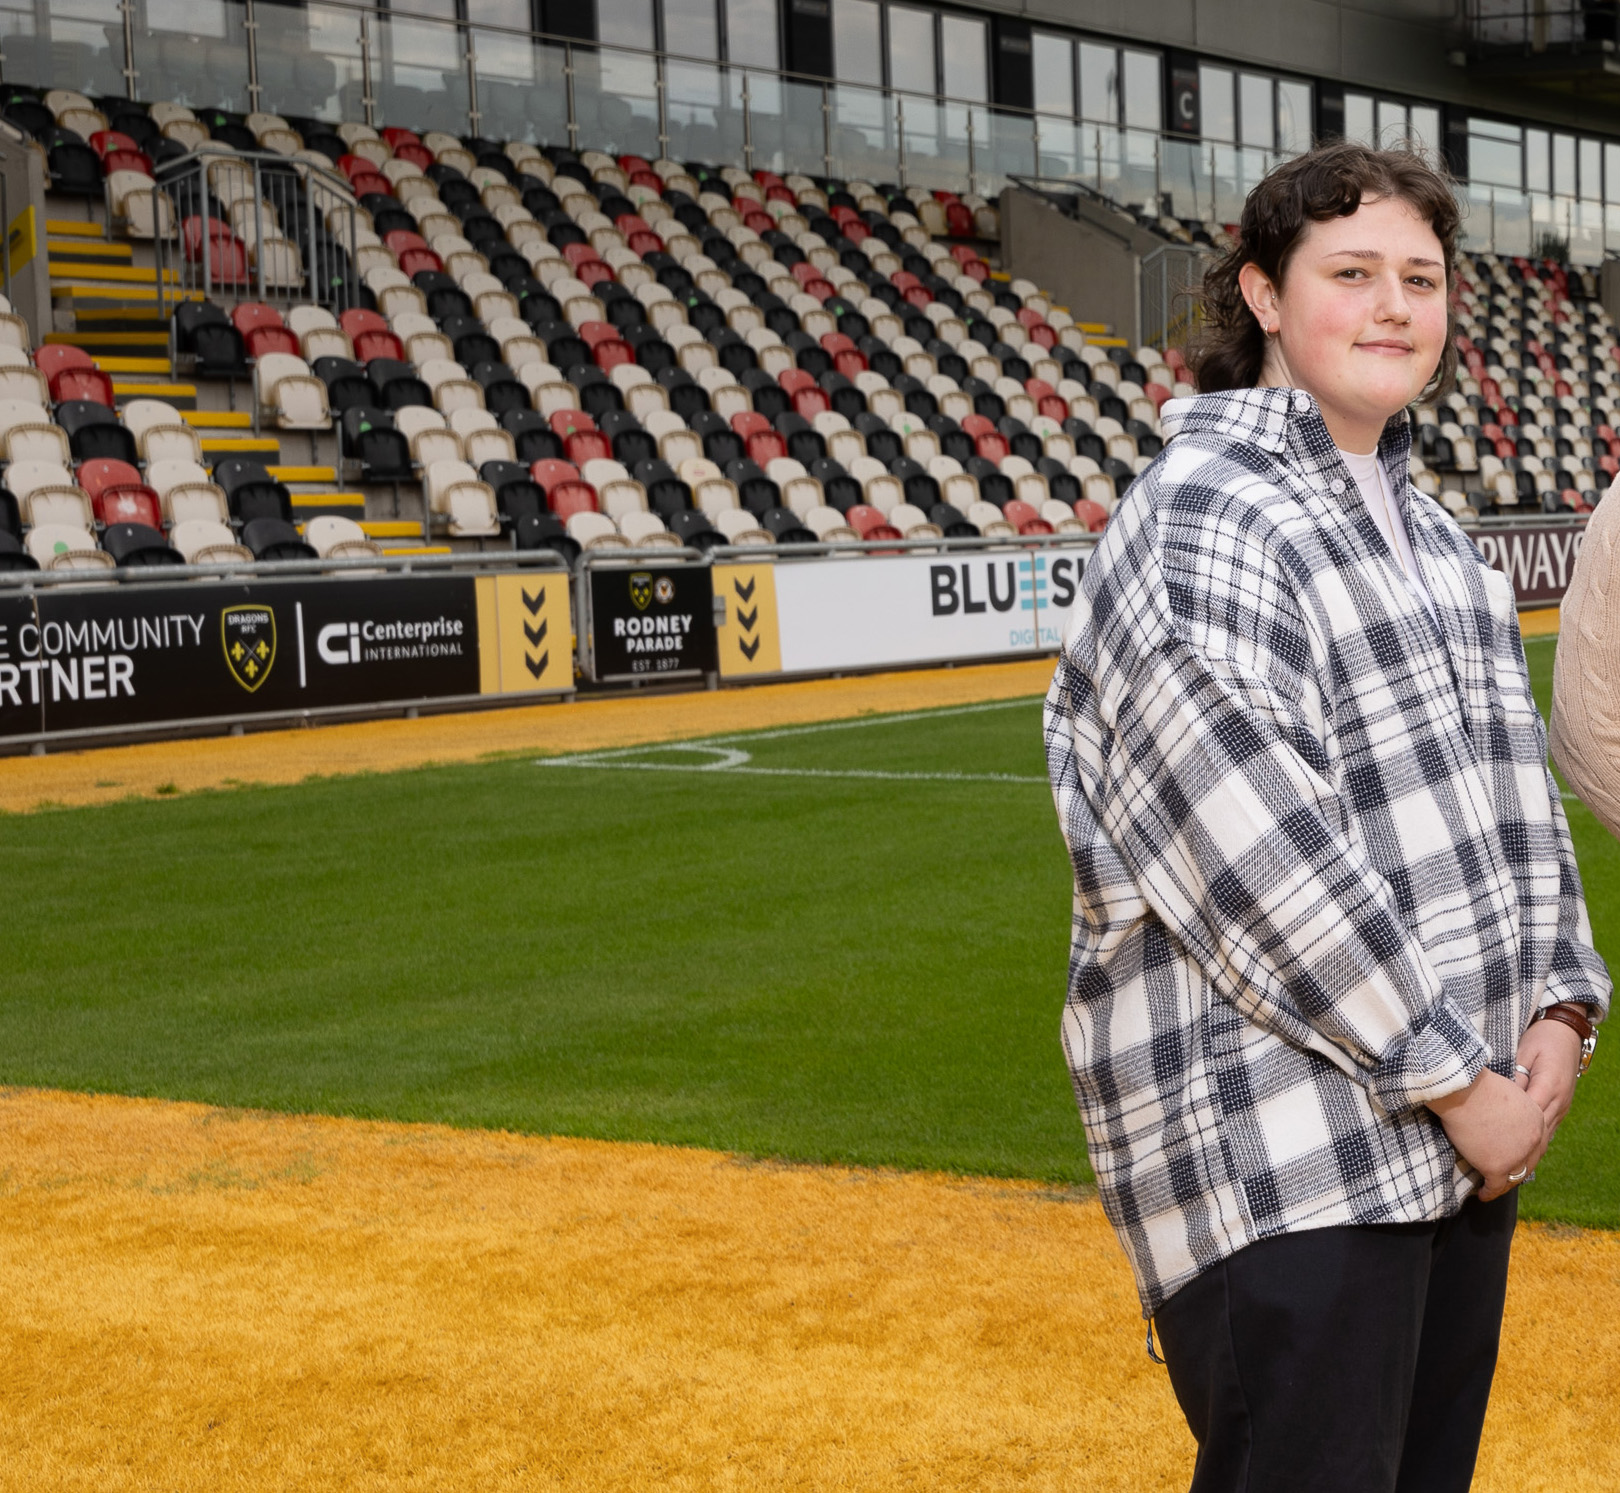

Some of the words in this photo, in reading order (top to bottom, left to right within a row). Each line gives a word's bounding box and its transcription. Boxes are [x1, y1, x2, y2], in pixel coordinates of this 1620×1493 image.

[1179, 91, 1194, 120] C
[227, 612, 269, 626] DRAGONS
[362, 616, 464, 643] Centerprise
[613, 614, 693, 637] RODNEY
[19, 613, 205, 657] COMMUNITY
[626, 635, 683, 653] PARADE
[364, 642, 464, 662] INTERNATIONAL
